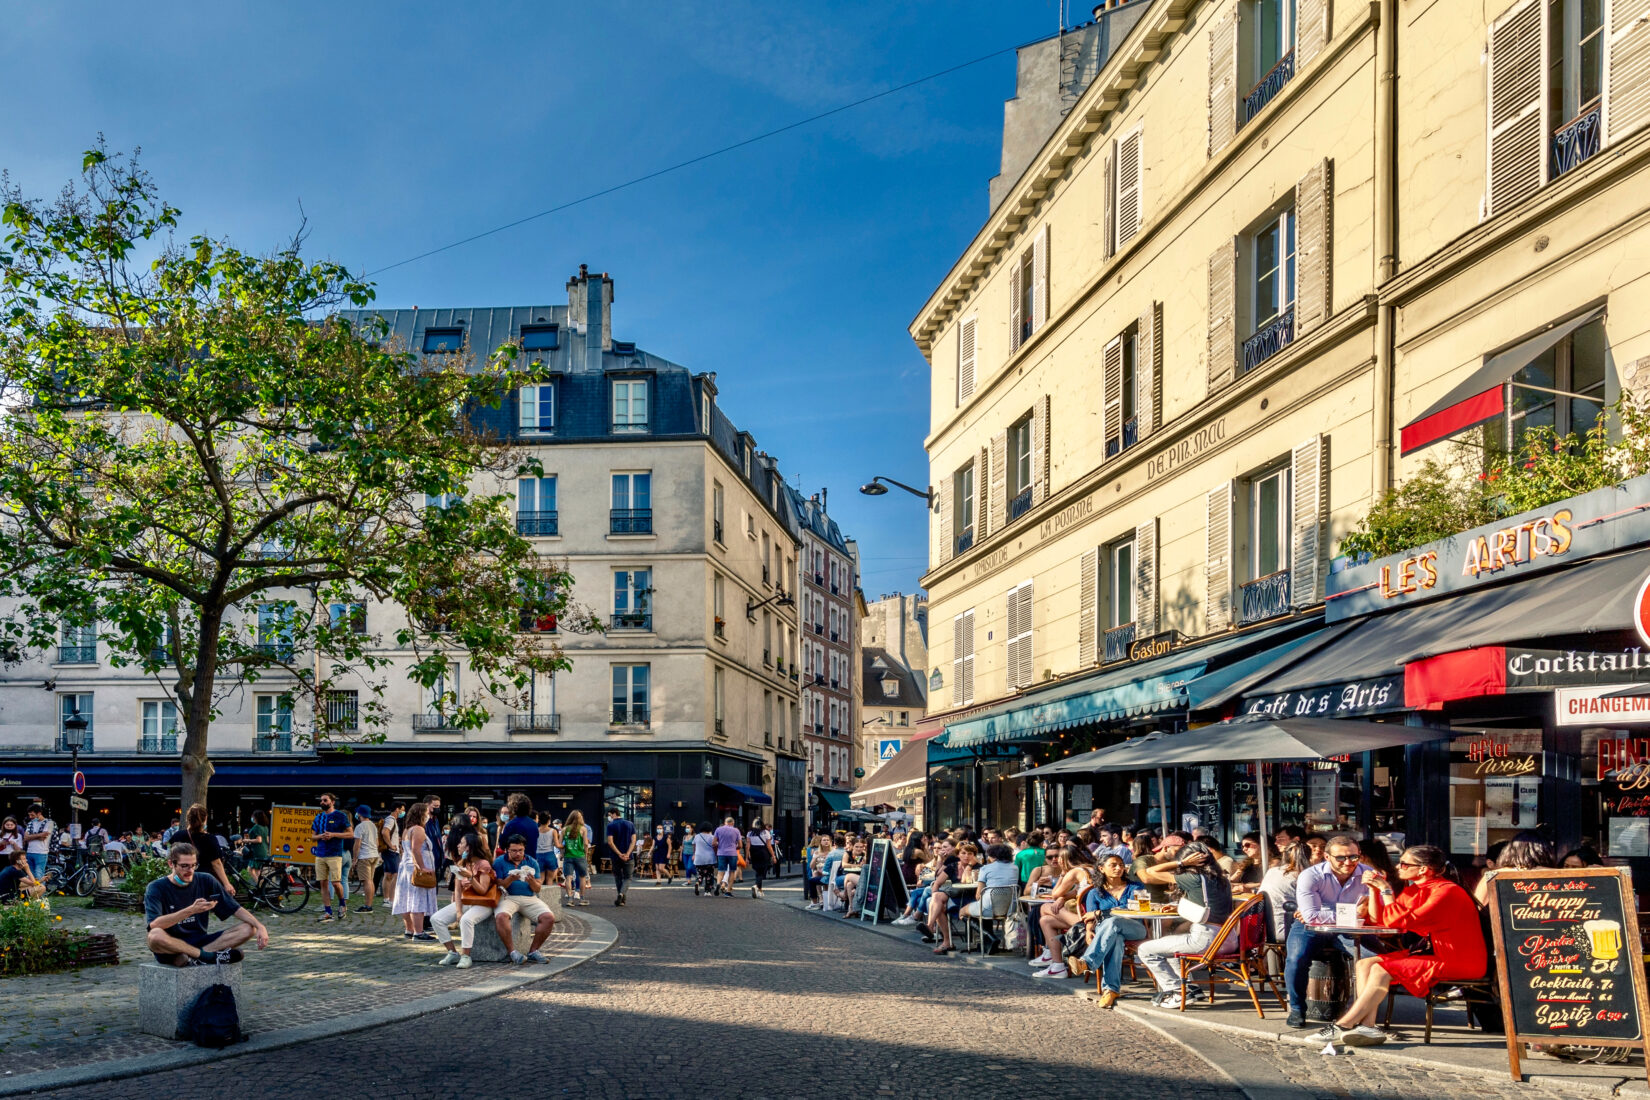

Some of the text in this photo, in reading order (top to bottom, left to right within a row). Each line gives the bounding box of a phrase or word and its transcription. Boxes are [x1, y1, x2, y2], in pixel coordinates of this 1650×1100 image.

[1379, 510, 1573, 599] LES ARTS
[1130, 638, 1170, 662] Gaston
[1247, 682, 1393, 716] Café des Arts
[1568, 695, 1650, 714] CHANGEM
[1465, 738, 1511, 763] After
[1476, 755, 1535, 777] work
[1616, 772, 1634, 781] de
[1528, 893, 1587, 910] Happy
[1514, 907, 1552, 920] Hours
[1530, 975, 1595, 990] Cocktails
[1535, 1004, 1595, 1028] Spritz
